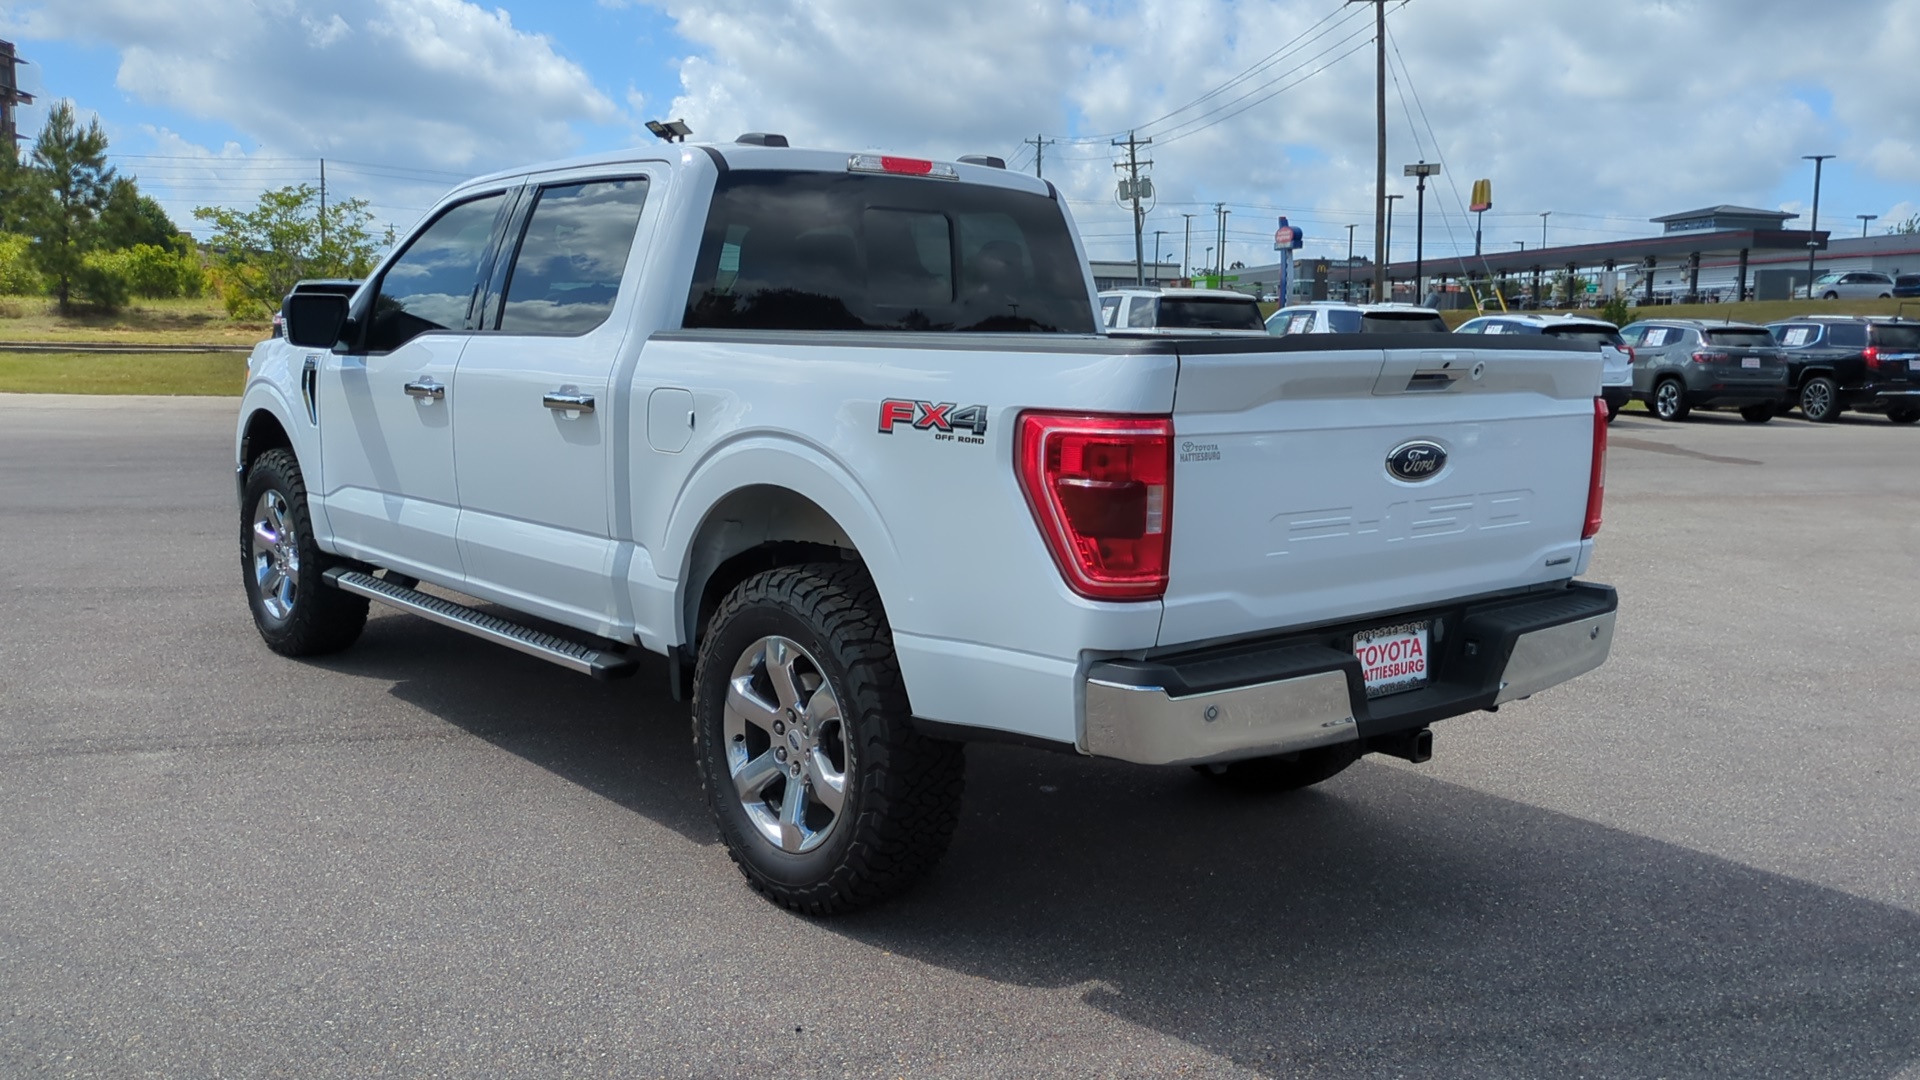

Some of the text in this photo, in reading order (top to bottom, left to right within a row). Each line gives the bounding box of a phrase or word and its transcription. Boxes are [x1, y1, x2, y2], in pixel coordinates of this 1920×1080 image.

[878, 397, 988, 435] FX4
[935, 433, 985, 445] OFF ROAD
[1194, 444, 1219, 453] TOYOTA
[1180, 452, 1221, 463] HATTIESBURG
[1403, 449, 1437, 473] Ford
[1266, 488, 1535, 557] F-150
[1357, 621, 1428, 642] 601-544-9630
[1356, 637, 1423, 666] TOYOTA
[1363, 659, 1425, 682] ATTIESBURG
